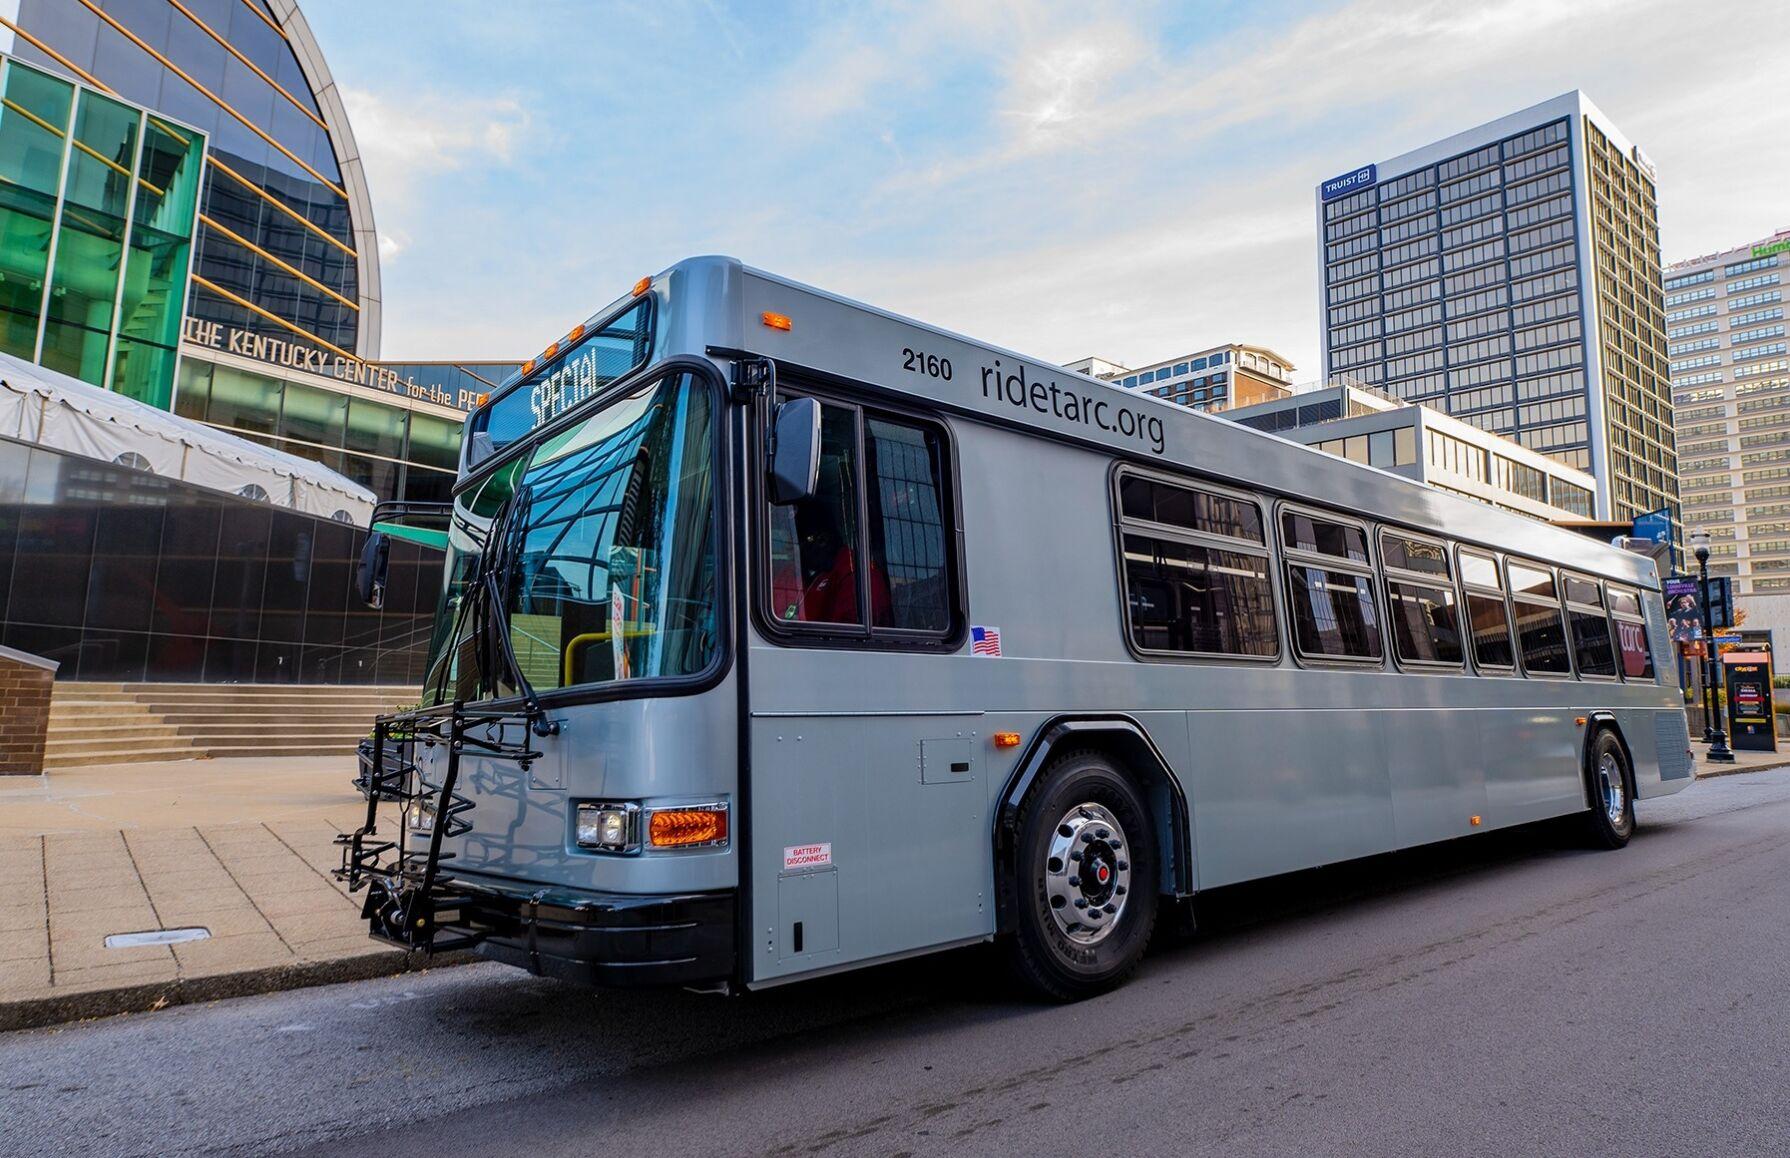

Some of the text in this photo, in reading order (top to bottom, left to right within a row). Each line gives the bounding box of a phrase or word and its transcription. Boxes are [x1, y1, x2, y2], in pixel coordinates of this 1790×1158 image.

[1326, 175, 1357, 193] TRUIST
[185, 316, 223, 348] THE
[229, 328, 328, 376] KENTUCKY
[334, 356, 397, 393] CENTER
[407, 376, 426, 399] for
[430, 384, 452, 406] the
[902, 348, 952, 381] 2160
[530, 347, 603, 430] SPECIAL
[981, 360, 1165, 454] ridetarc.org
[1617, 621, 1643, 653] tarc
[786, 854, 828, 866] DISCONNECT
[793, 847, 822, 856] BATTERY
